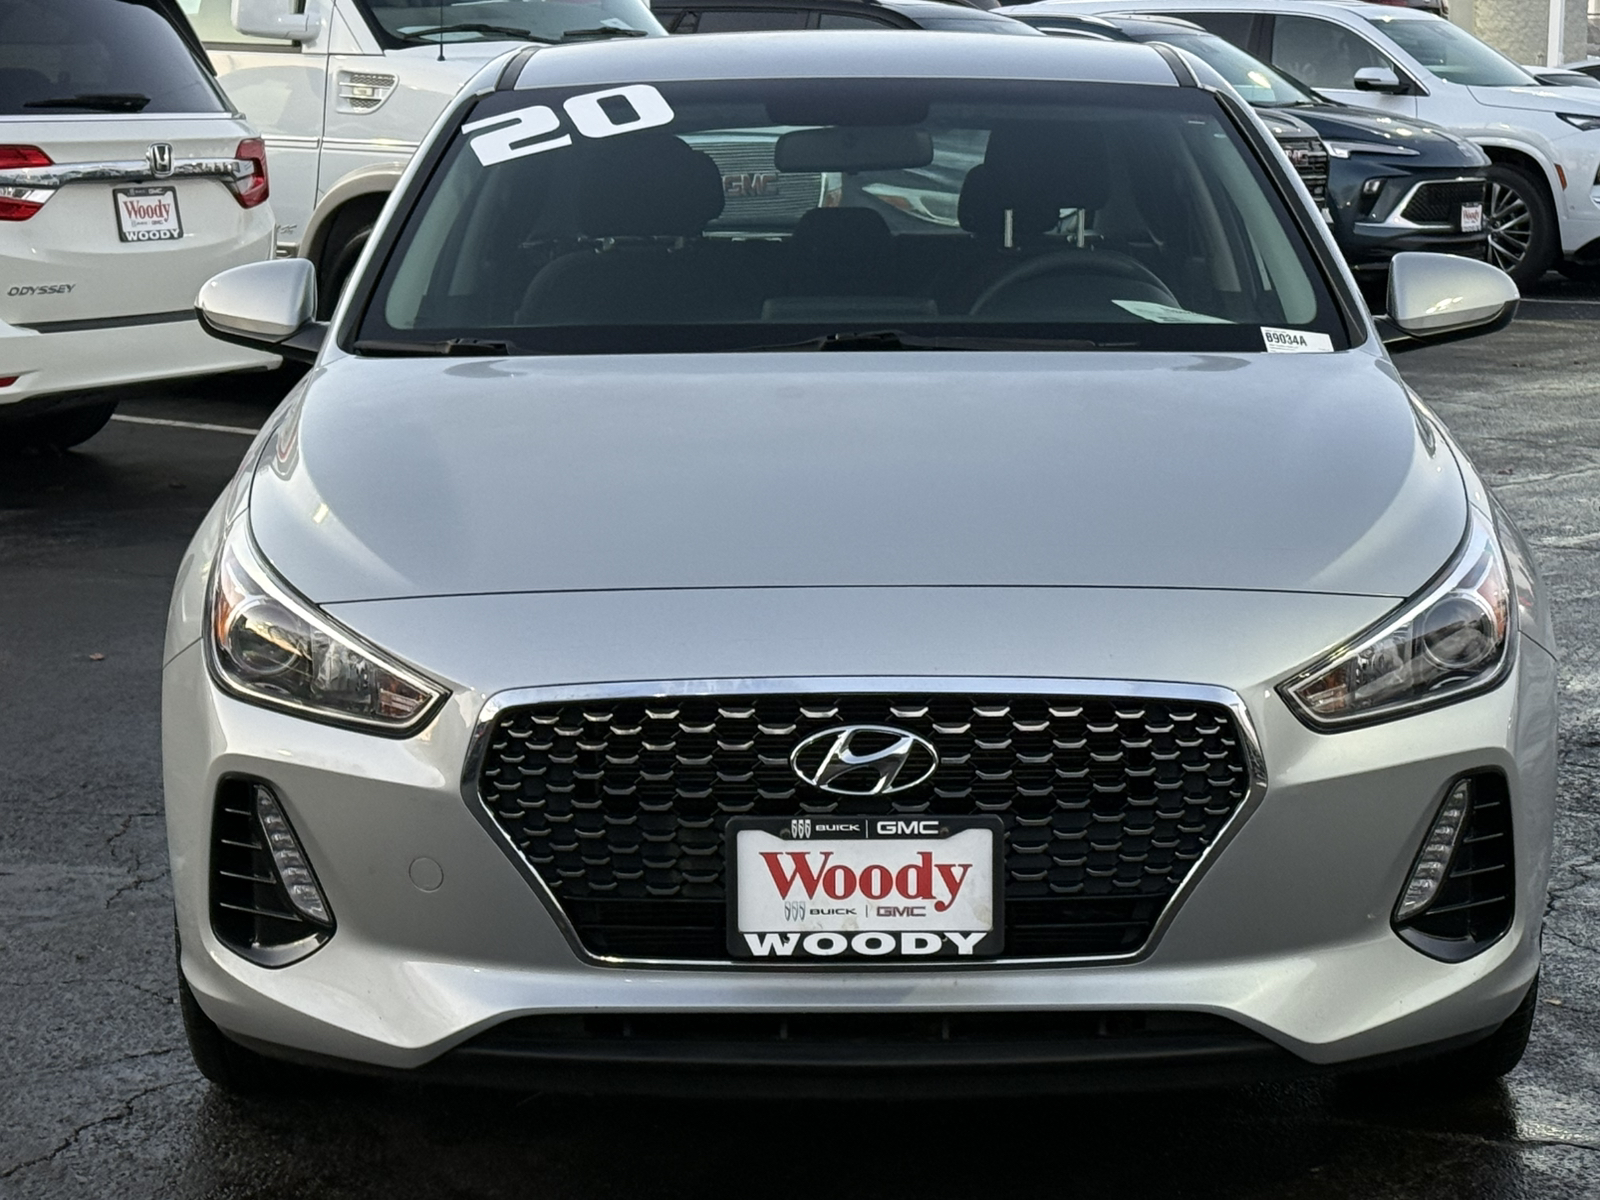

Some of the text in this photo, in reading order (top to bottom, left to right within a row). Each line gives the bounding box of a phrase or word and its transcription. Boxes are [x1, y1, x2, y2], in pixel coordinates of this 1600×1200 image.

[461, 84, 675, 167] 20
[722, 173, 778, 196] GMC
[122, 199, 171, 222] Woody
[125, 229, 180, 241] WOODY
[7, 283, 76, 297] ODYSSEY
[1265, 332, 1308, 347] B9034A
[815, 820, 939, 835] BUICK GMC
[758, 851, 973, 912] Woody
[809, 906, 927, 918] BUICK GMC
[743, 931, 988, 956] WOODY
